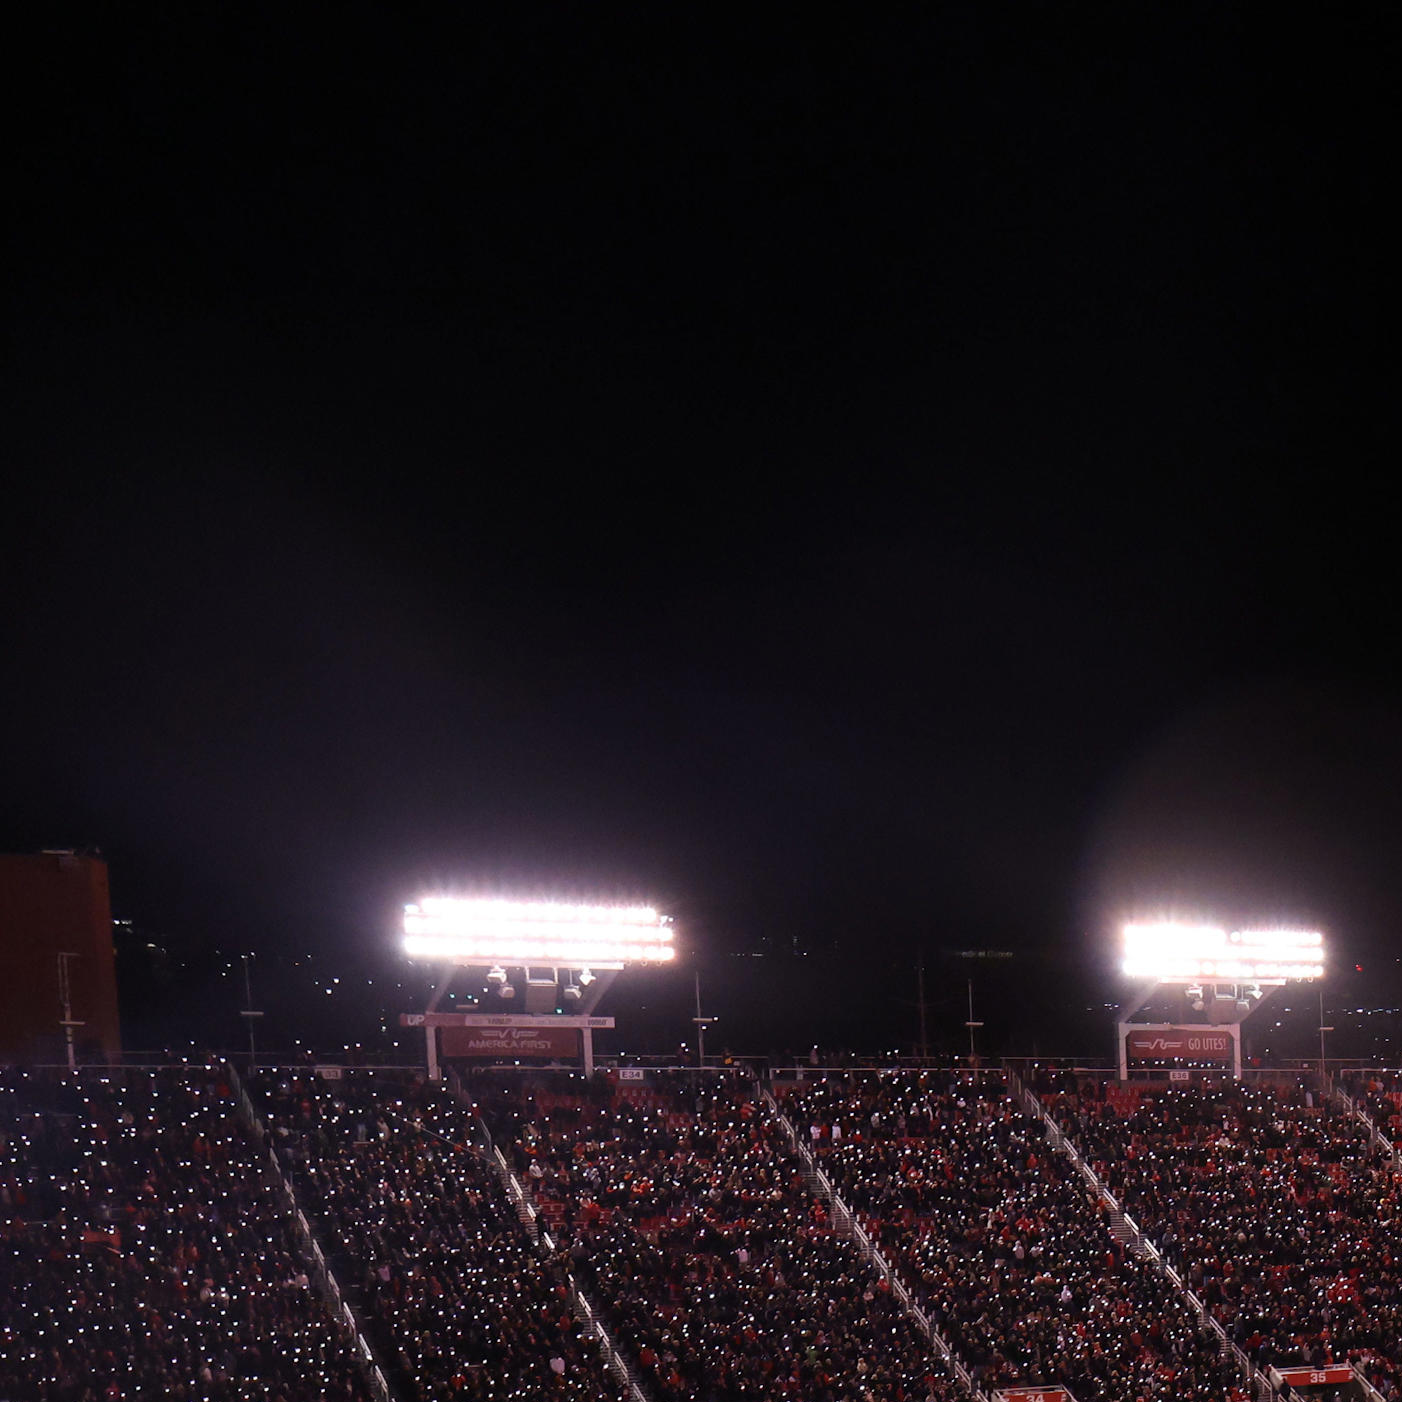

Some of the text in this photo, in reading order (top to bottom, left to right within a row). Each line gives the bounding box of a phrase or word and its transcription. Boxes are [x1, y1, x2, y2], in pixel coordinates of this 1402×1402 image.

[1188, 1038, 1226, 1050] GO UTES!
[622, 1071, 640, 1079] E34
[1310, 1373, 1326, 1383] 35
